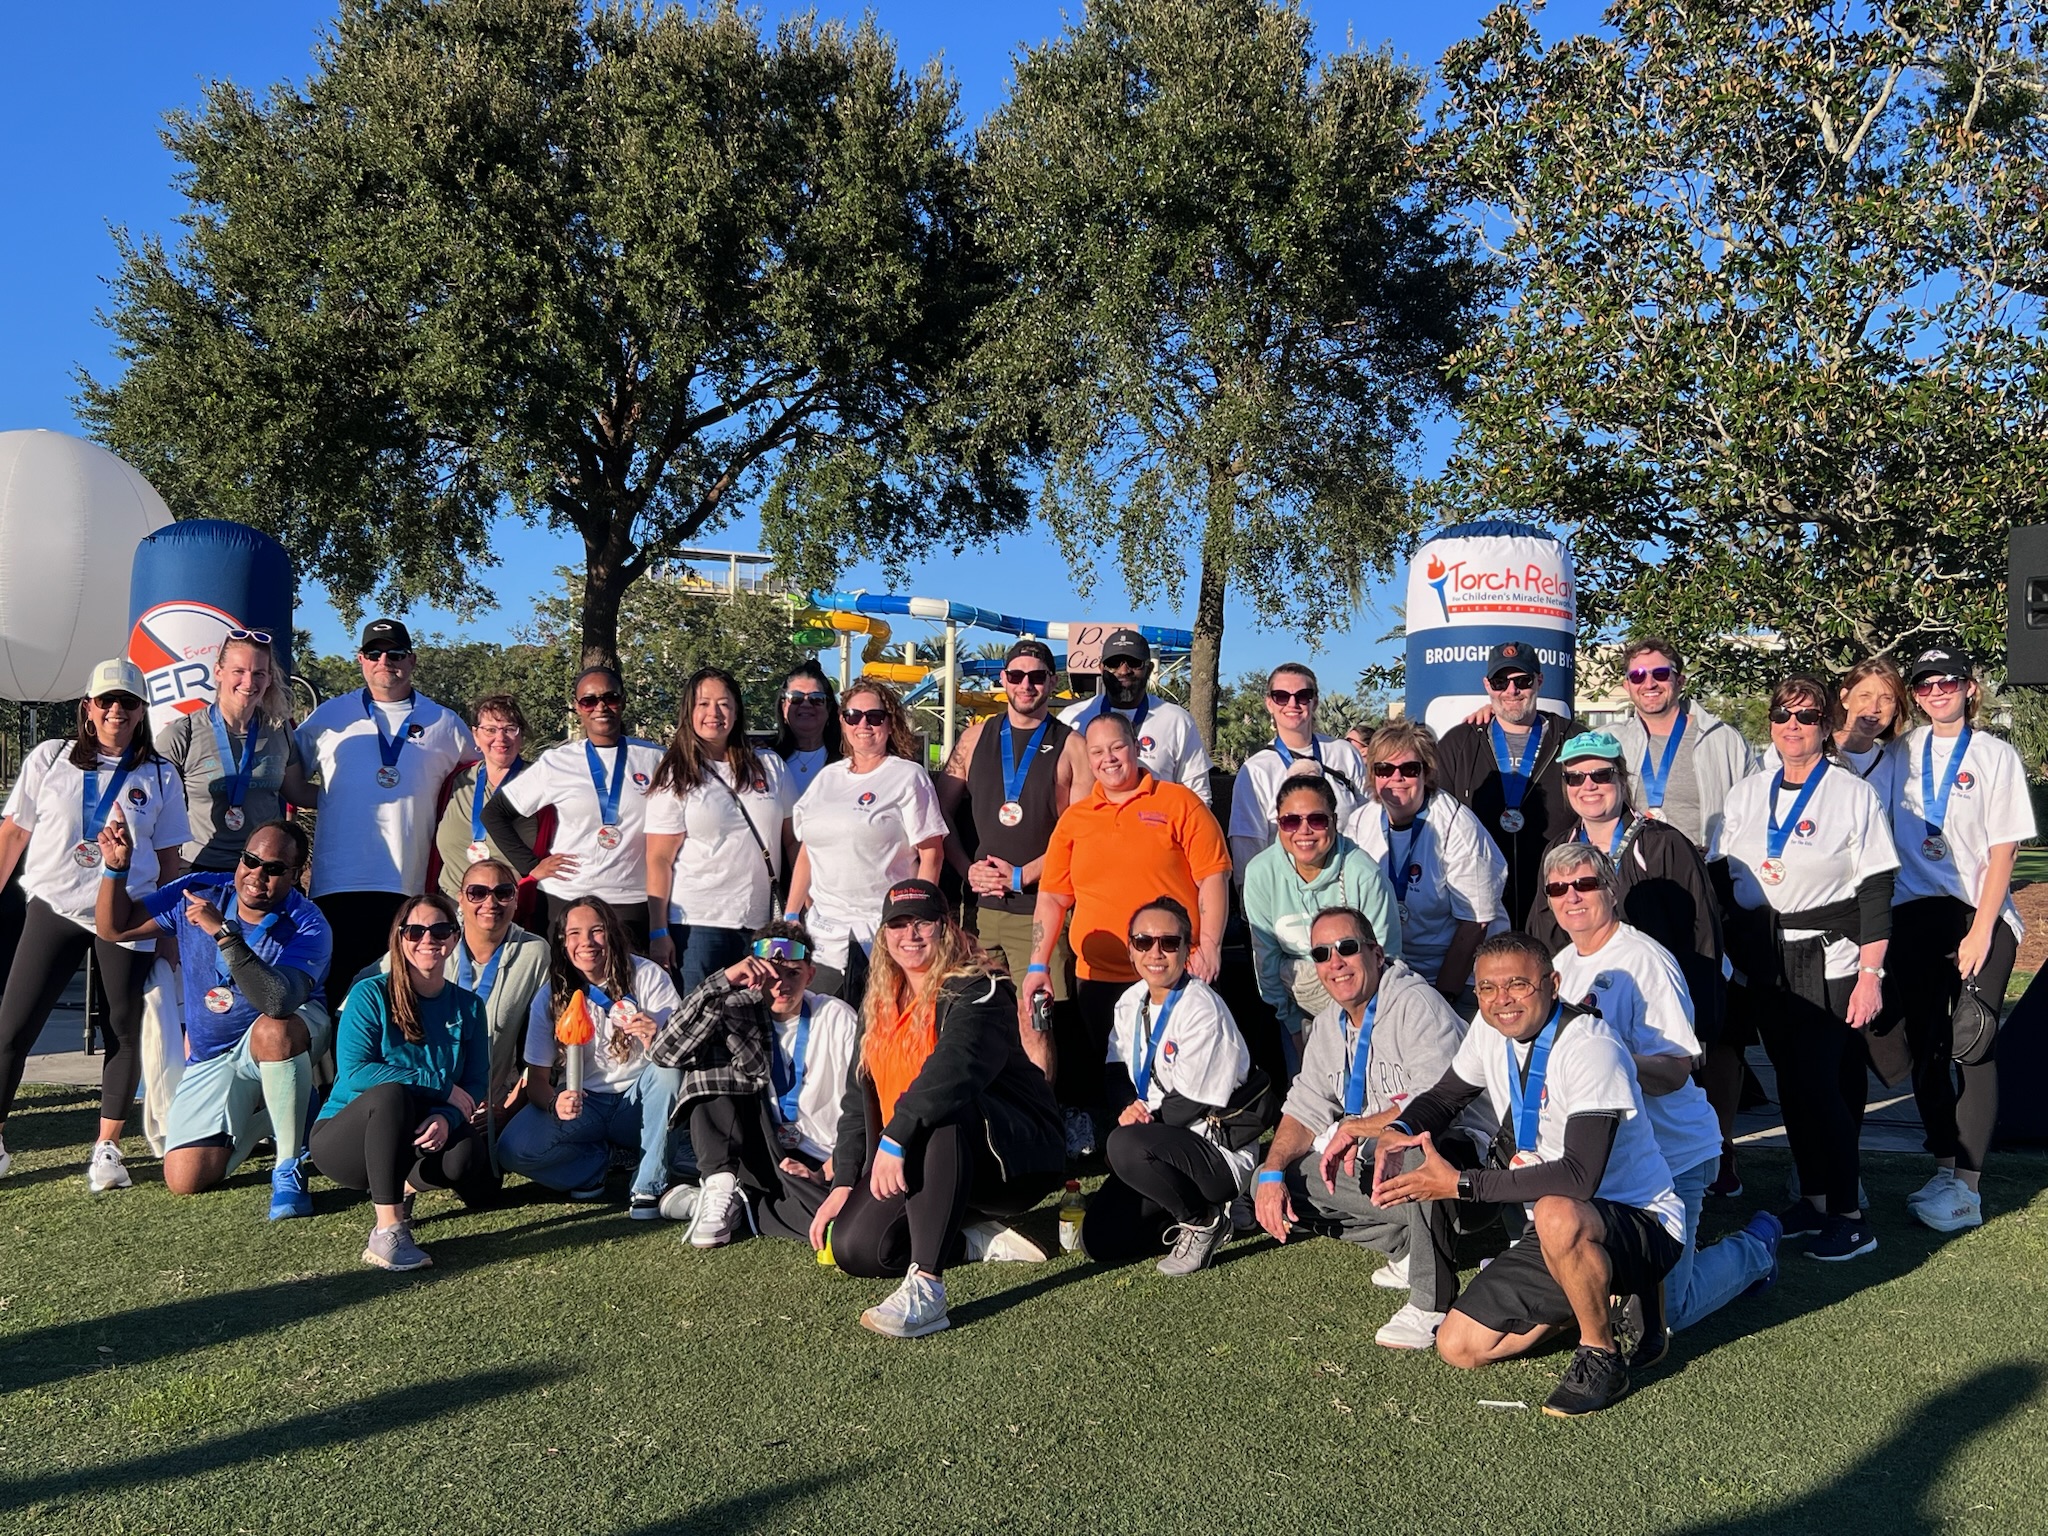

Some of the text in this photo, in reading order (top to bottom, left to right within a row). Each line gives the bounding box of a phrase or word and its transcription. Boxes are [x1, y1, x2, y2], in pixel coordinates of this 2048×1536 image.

[1448, 561, 1573, 600] Torch Relay
[1462, 592, 1511, 602] Children's
[1512, 593, 1545, 604] Miracle
[1425, 645, 1495, 665] BROUGH
[146, 662, 217, 708] ER
